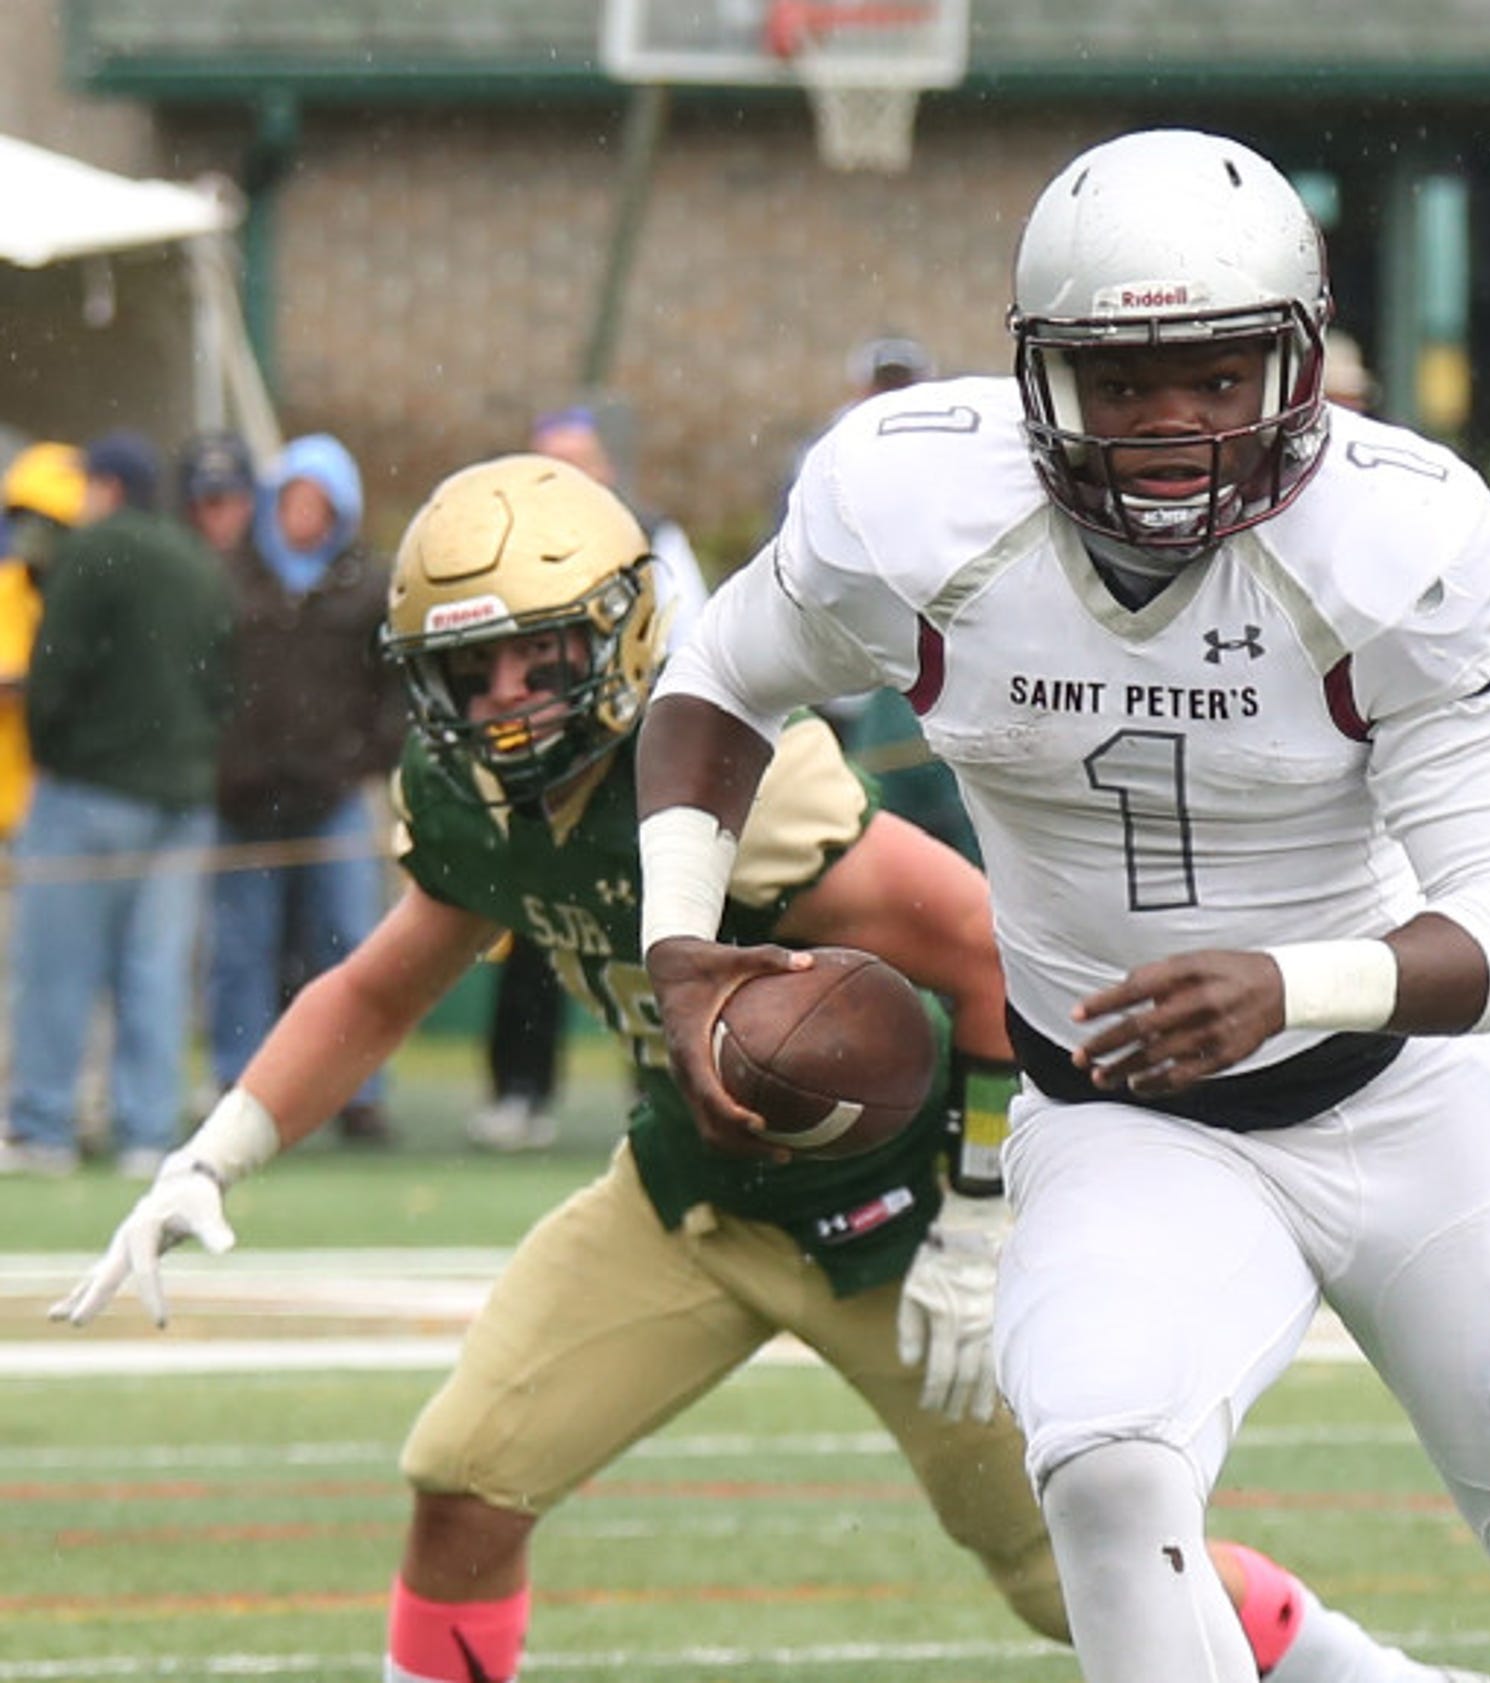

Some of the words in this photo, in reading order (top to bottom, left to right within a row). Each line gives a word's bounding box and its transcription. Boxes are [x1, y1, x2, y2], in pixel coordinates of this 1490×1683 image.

[1121, 286, 1187, 307] Riddell
[878, 405, 982, 436] 1
[1346, 440, 1448, 482] 1
[1010, 676, 1106, 713] SAINT
[1126, 685, 1259, 720] PETER'S
[1083, 728, 1199, 912] 1
[522, 894, 612, 955] SJR
